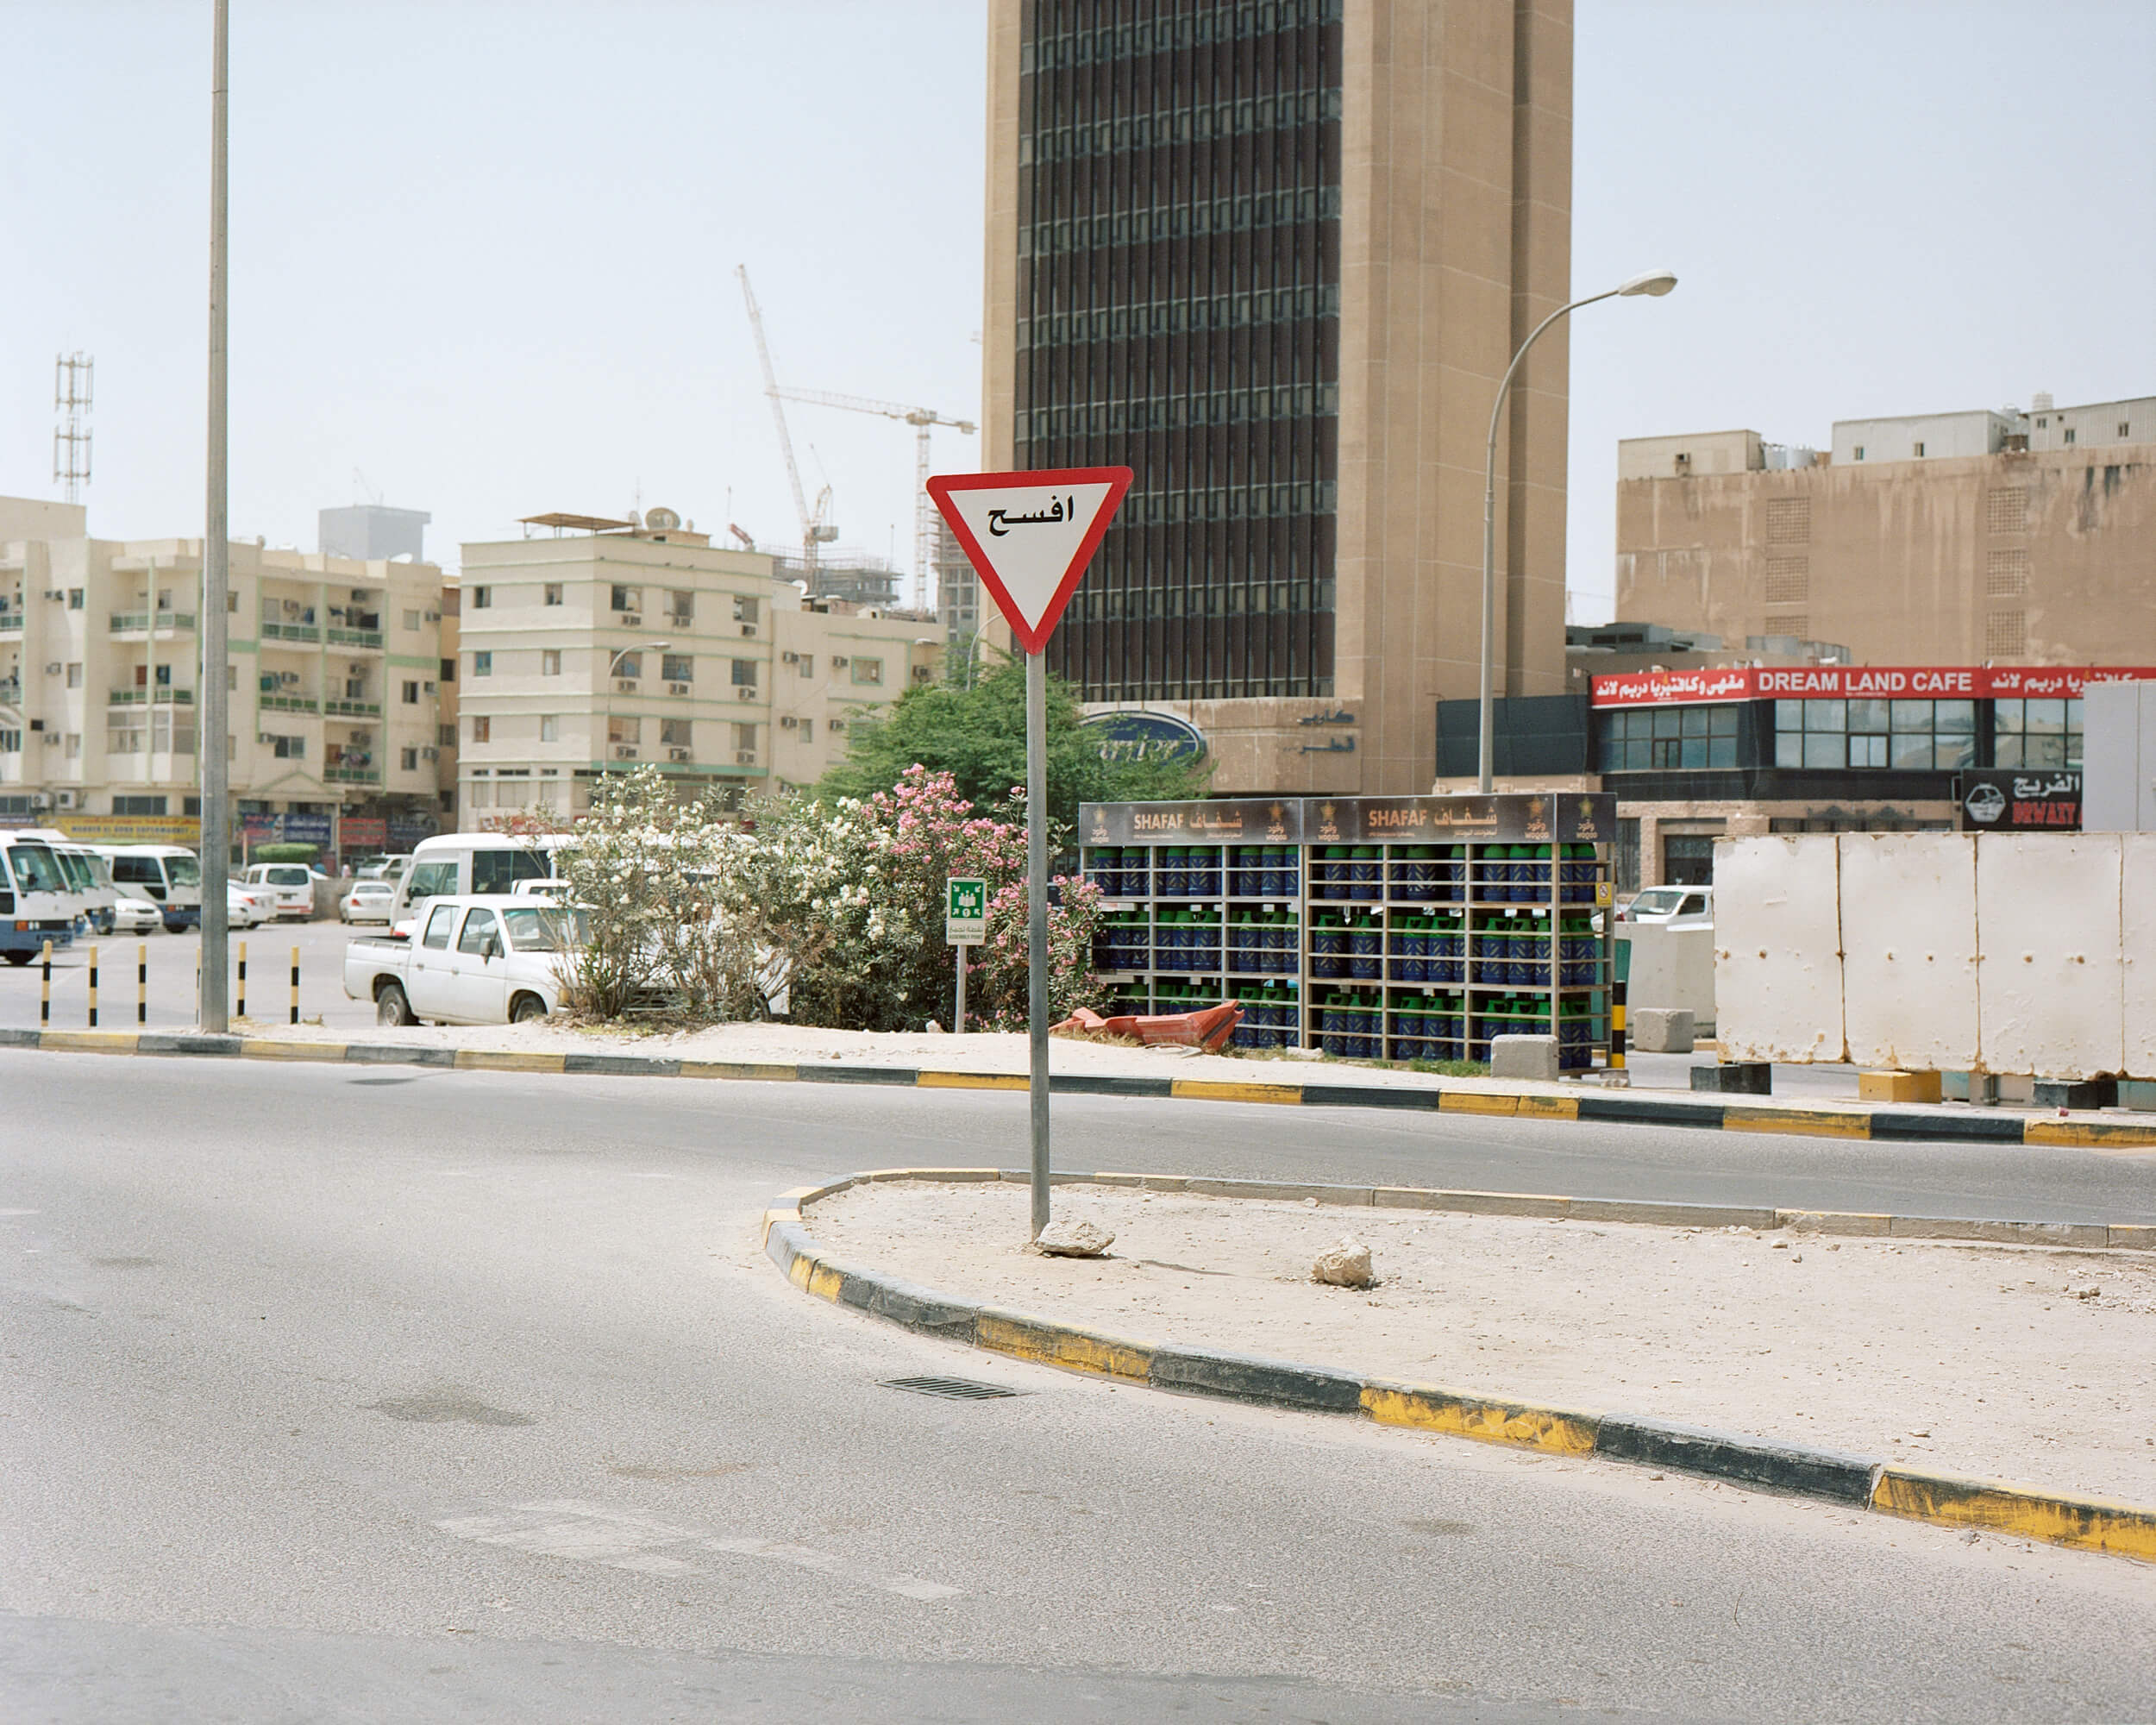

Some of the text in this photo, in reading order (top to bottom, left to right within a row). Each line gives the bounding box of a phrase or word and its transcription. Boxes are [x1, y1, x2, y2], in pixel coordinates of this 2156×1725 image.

[987, 495, 1075, 536] افسح
[1596, 680, 1618, 697] لاند
[1706, 674, 1745, 696] مقهى
[1758, 672, 1973, 691] DREAM LAND CAFE
[1990, 672, 2021, 689] لاند
[2023, 677, 2064, 693] دريم
[1619, 683, 1648, 699] دريم
[1133, 812, 1184, 831] SHAFAF
[1189, 809, 1243, 829] شفاف
[1369, 809, 1428, 827] SHAFAF
[1434, 806, 1498, 825] شفاف
